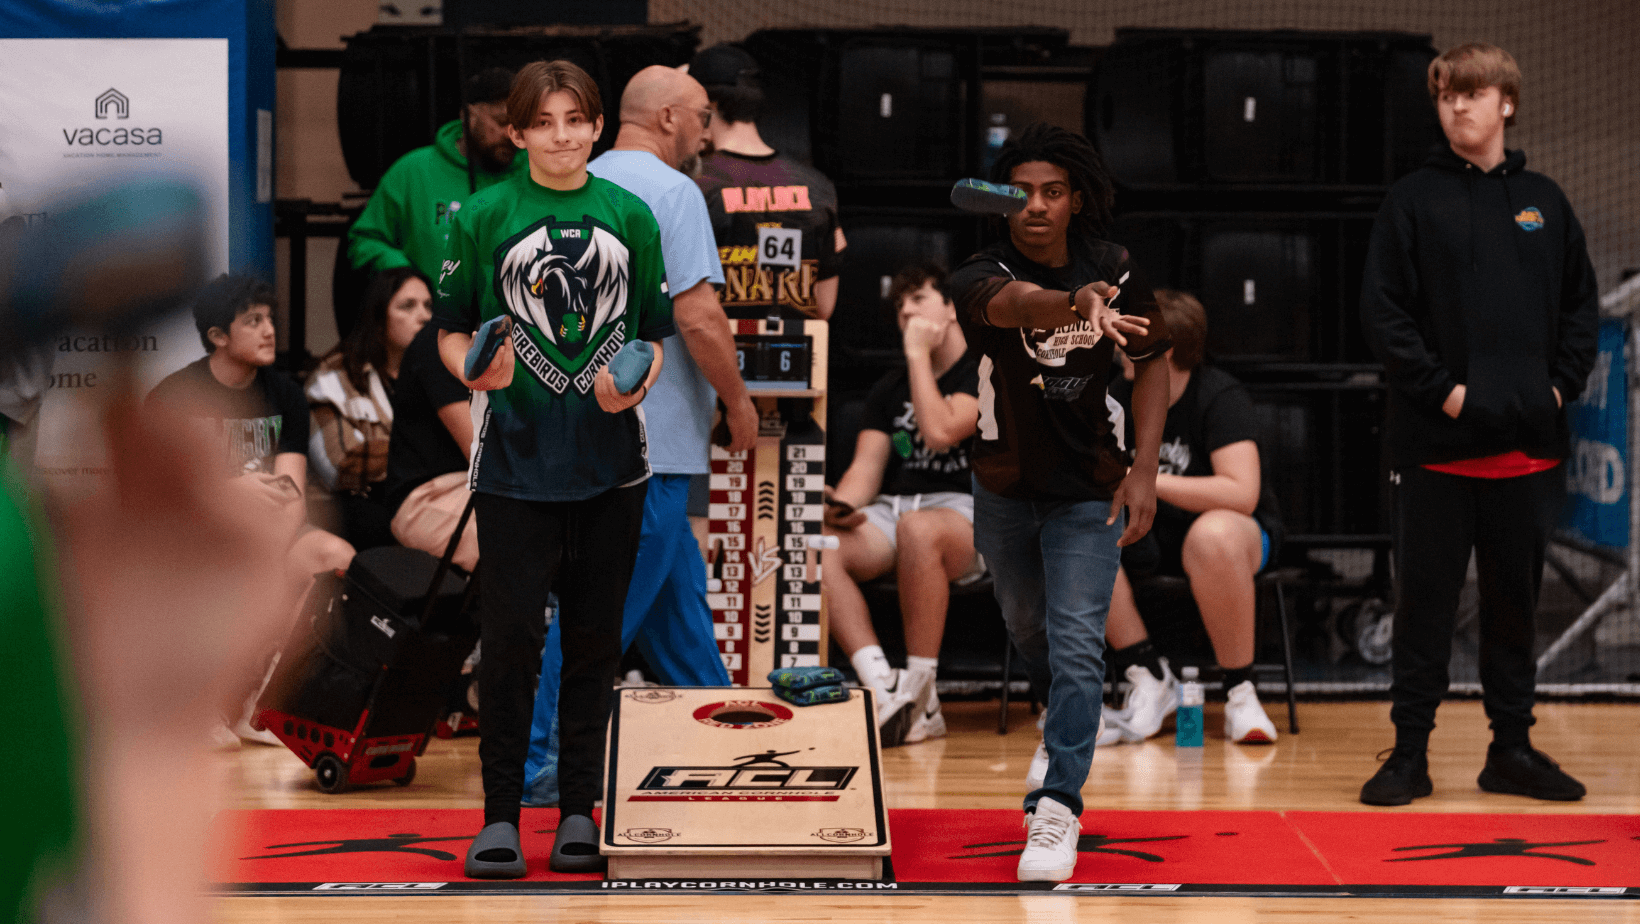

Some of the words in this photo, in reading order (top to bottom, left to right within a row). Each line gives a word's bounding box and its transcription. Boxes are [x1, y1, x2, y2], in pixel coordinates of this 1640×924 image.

[63, 127, 162, 146] vacasa
[560, 228, 581, 239] WCR
[764, 235, 795, 260] 64
[718, 245, 759, 264] EAM
[54, 333, 158, 352] acation
[1053, 335, 1069, 347] HIGH
[1070, 334, 1096, 346] SCHOOL
[513, 325, 567, 391] FIREBIRDS
[779, 350, 791, 372] 6
[49, 371, 97, 389] ome
[793, 447, 806, 458] 21
[729, 476, 742, 488] 19
[792, 477, 805, 488] 19
[728, 506, 740, 517] 17
[792, 507, 804, 518] 17
[727, 536, 740, 547] 15
[791, 537, 803, 548] 15
[748, 535, 784, 588] VS
[726, 566, 738, 577] 13
[790, 567, 803, 578] 13
[726, 596, 737, 607] 11
[790, 597, 801, 608] 11
[727, 627, 735, 637] 9
[791, 627, 798, 638] 9
[725, 641, 735, 653] 8
[789, 641, 799, 653] 8
[727, 656, 733, 667] 7
[790, 657, 797, 667] 7
[647, 767, 849, 790] ACL
[601, 880, 899, 890] IPLAYCORNHOLE.COM
